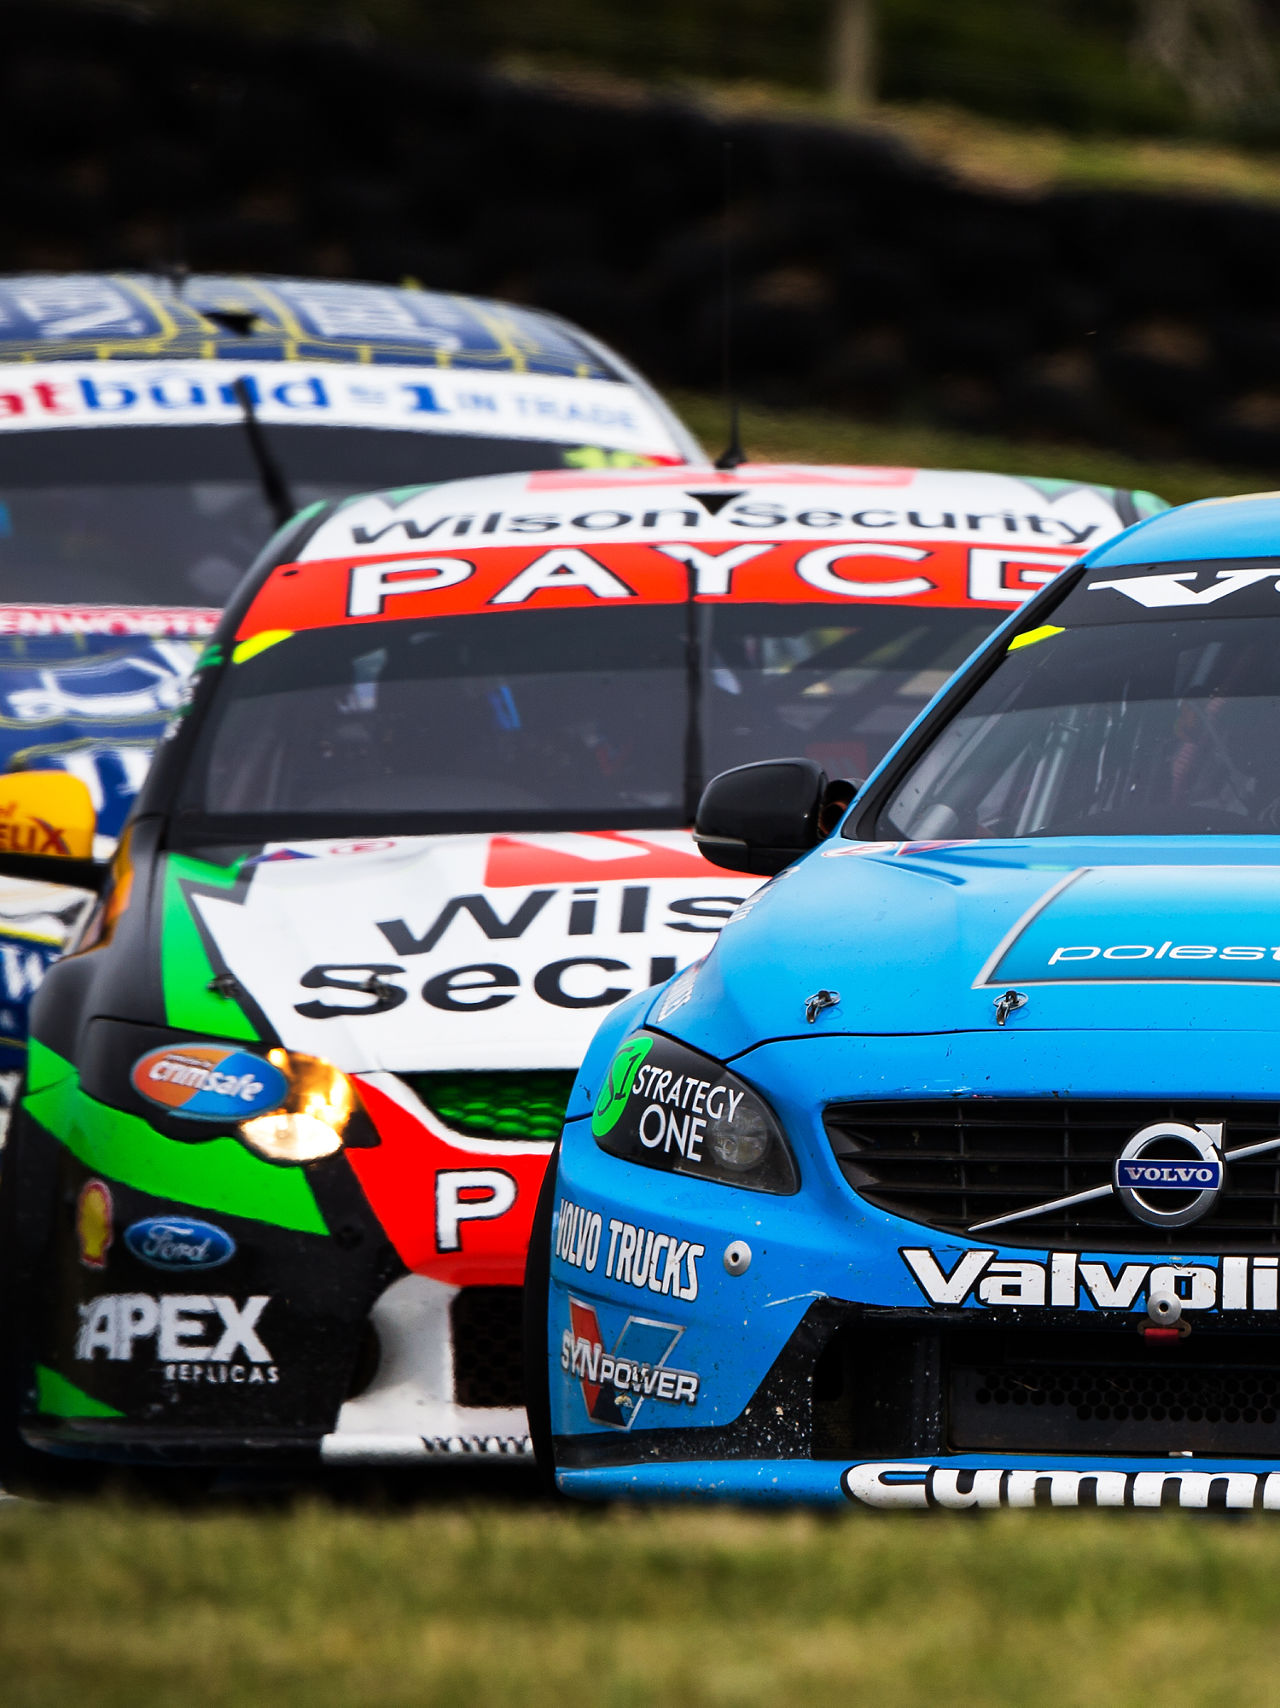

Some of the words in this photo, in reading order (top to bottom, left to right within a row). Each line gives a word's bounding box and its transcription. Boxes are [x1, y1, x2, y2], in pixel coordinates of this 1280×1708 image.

[351, 510, 699, 544] Wilson
[730, 503, 1099, 543] Security
[345, 541, 1079, 618] PAYCE
[632, 1064, 744, 1123] STRATEGY
[639, 1104, 707, 1162] ONE
[1123, 1167, 1214, 1182] VOLVO
[142, 1224, 213, 1261] Ford
[555, 1198, 602, 1272] VOLVO
[605, 1218, 705, 1302] TRUCKS
[75, 1293, 274, 1362] APEX
[164, 1364, 280, 1384] REPLICAS
